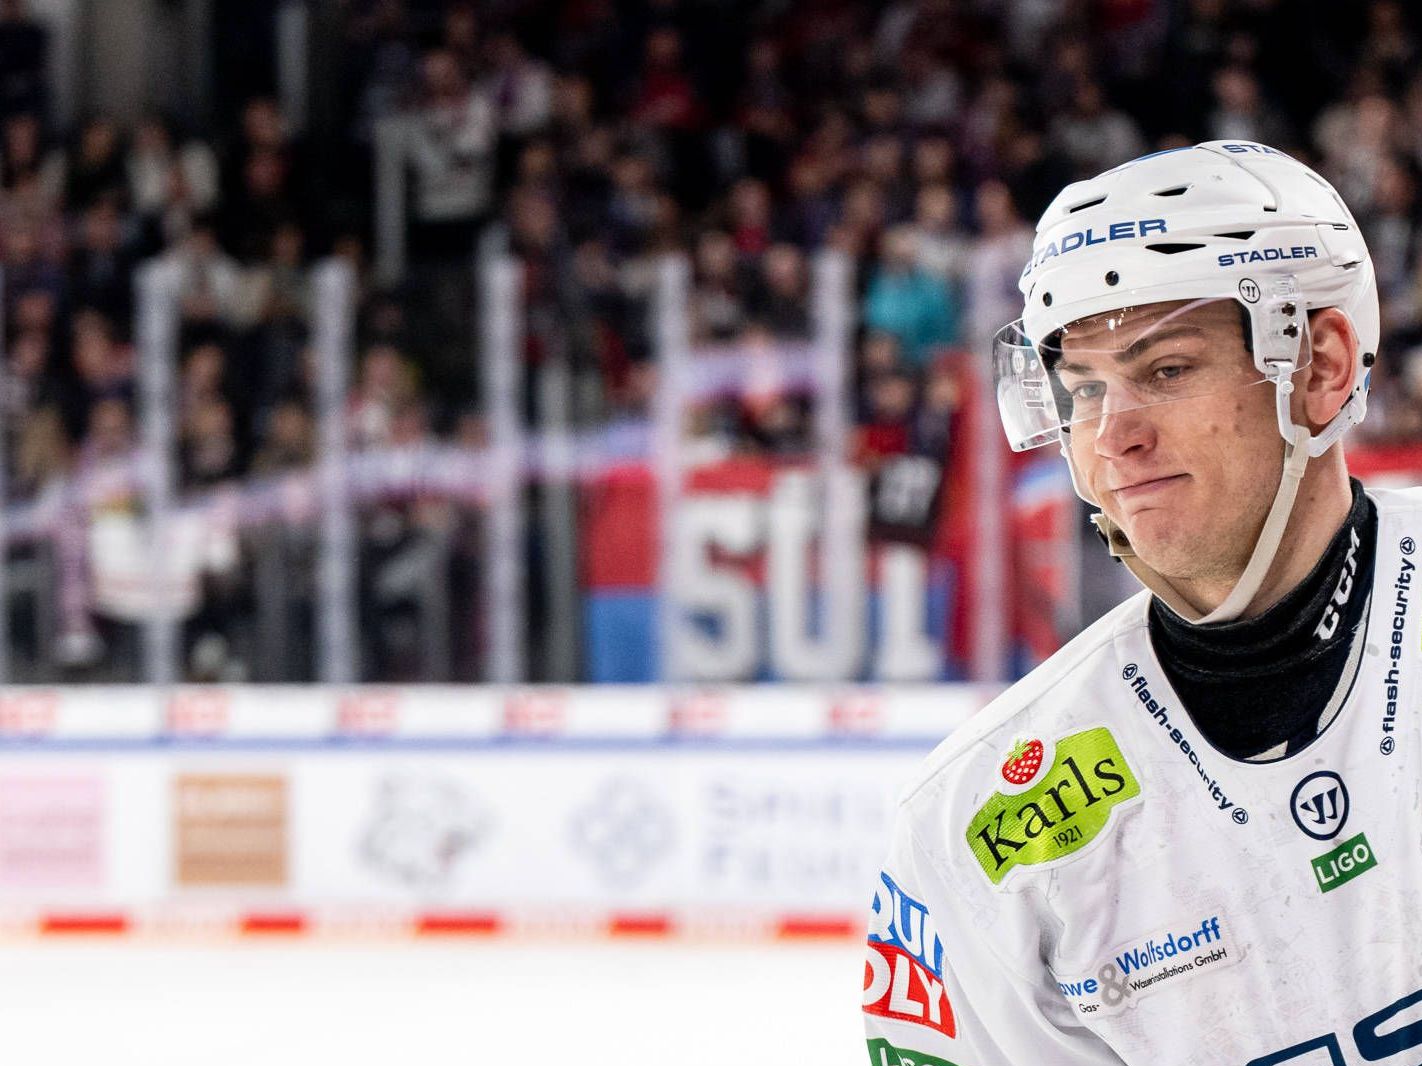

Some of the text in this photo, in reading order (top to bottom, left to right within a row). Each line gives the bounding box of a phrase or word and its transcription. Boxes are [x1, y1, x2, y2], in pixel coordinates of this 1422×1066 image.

[1218, 246, 1318, 267] STADLER
[1312, 526, 1361, 640] CCM
[1382, 558, 1416, 733] flash-security
[1130, 676, 1234, 810] flash-security
[977, 752, 1126, 872] Karls
[1053, 825, 1084, 849] 1921
[1316, 843, 1369, 887] LIGO
[1115, 916, 1221, 975] Wolfsdorff
[1194, 948, 1227, 967] GmbH
[1099, 963, 1132, 1007] &
